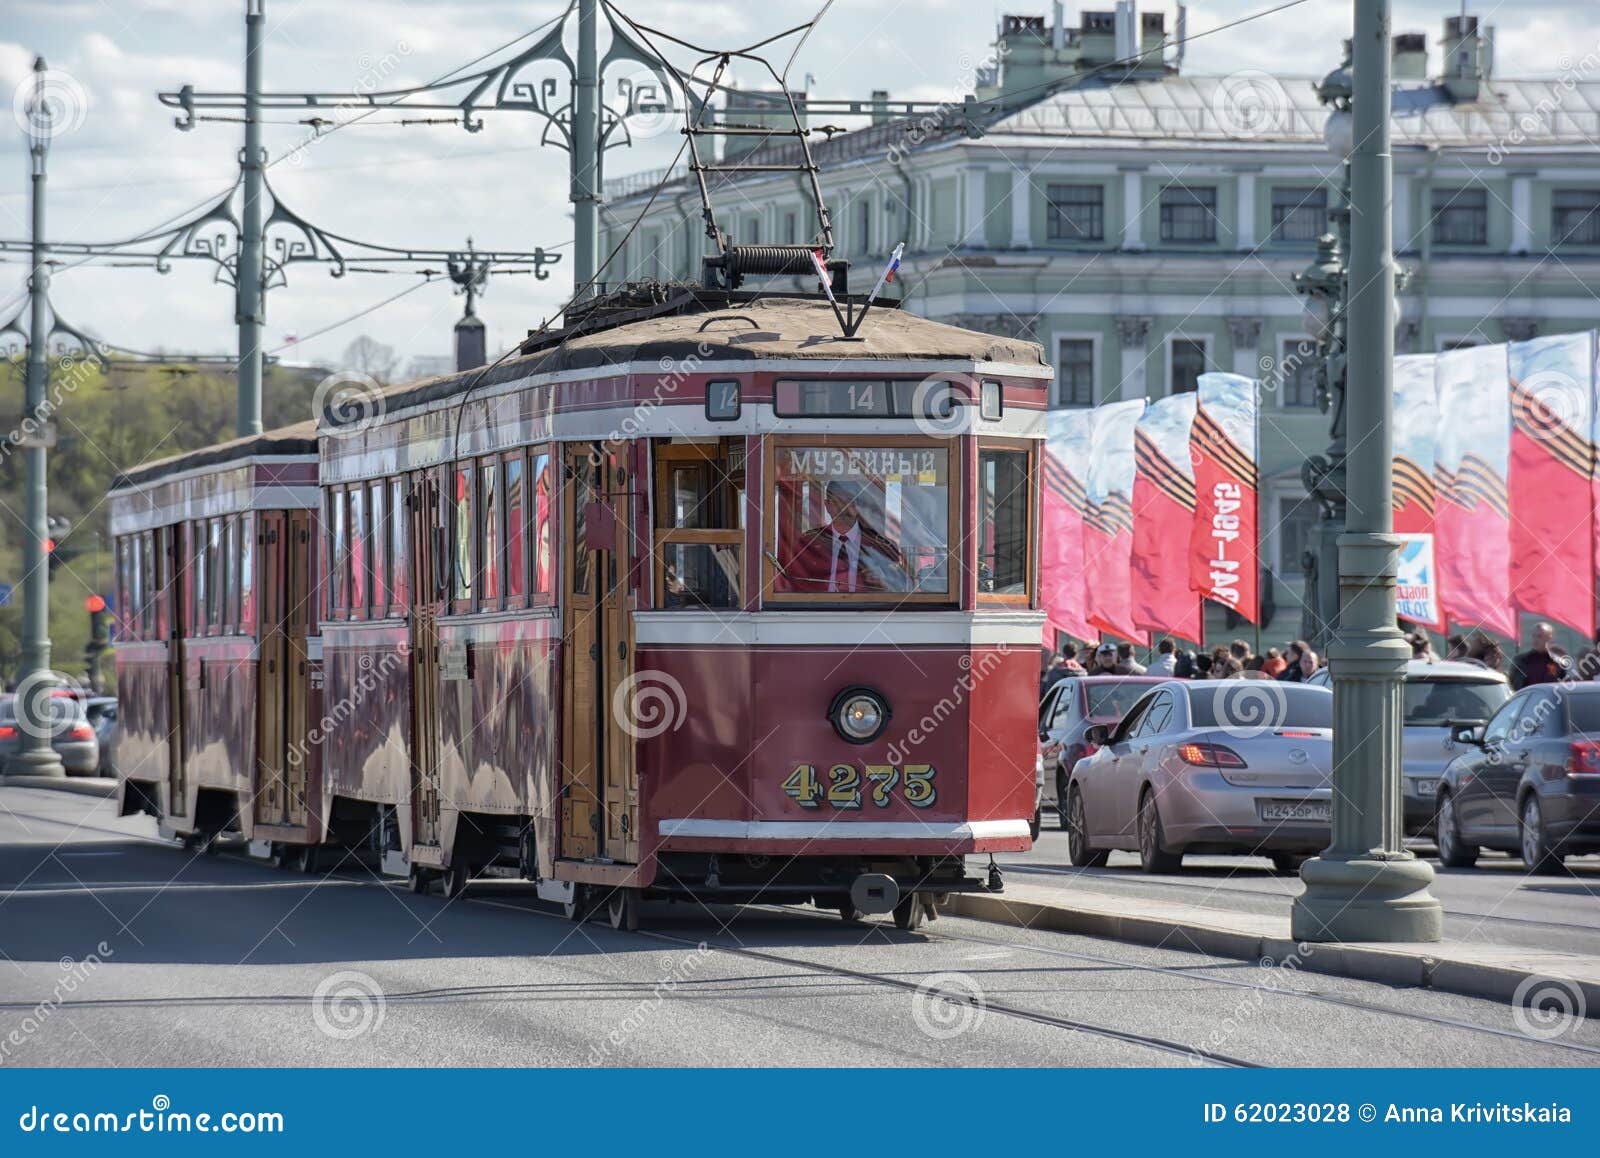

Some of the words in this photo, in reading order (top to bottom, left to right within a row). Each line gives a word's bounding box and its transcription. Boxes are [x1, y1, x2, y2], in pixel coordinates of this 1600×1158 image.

[847, 385, 874, 410] 14
[790, 450, 935, 475] МУЗЕЙНЫЙ
[781, 763, 937, 809] 4275
